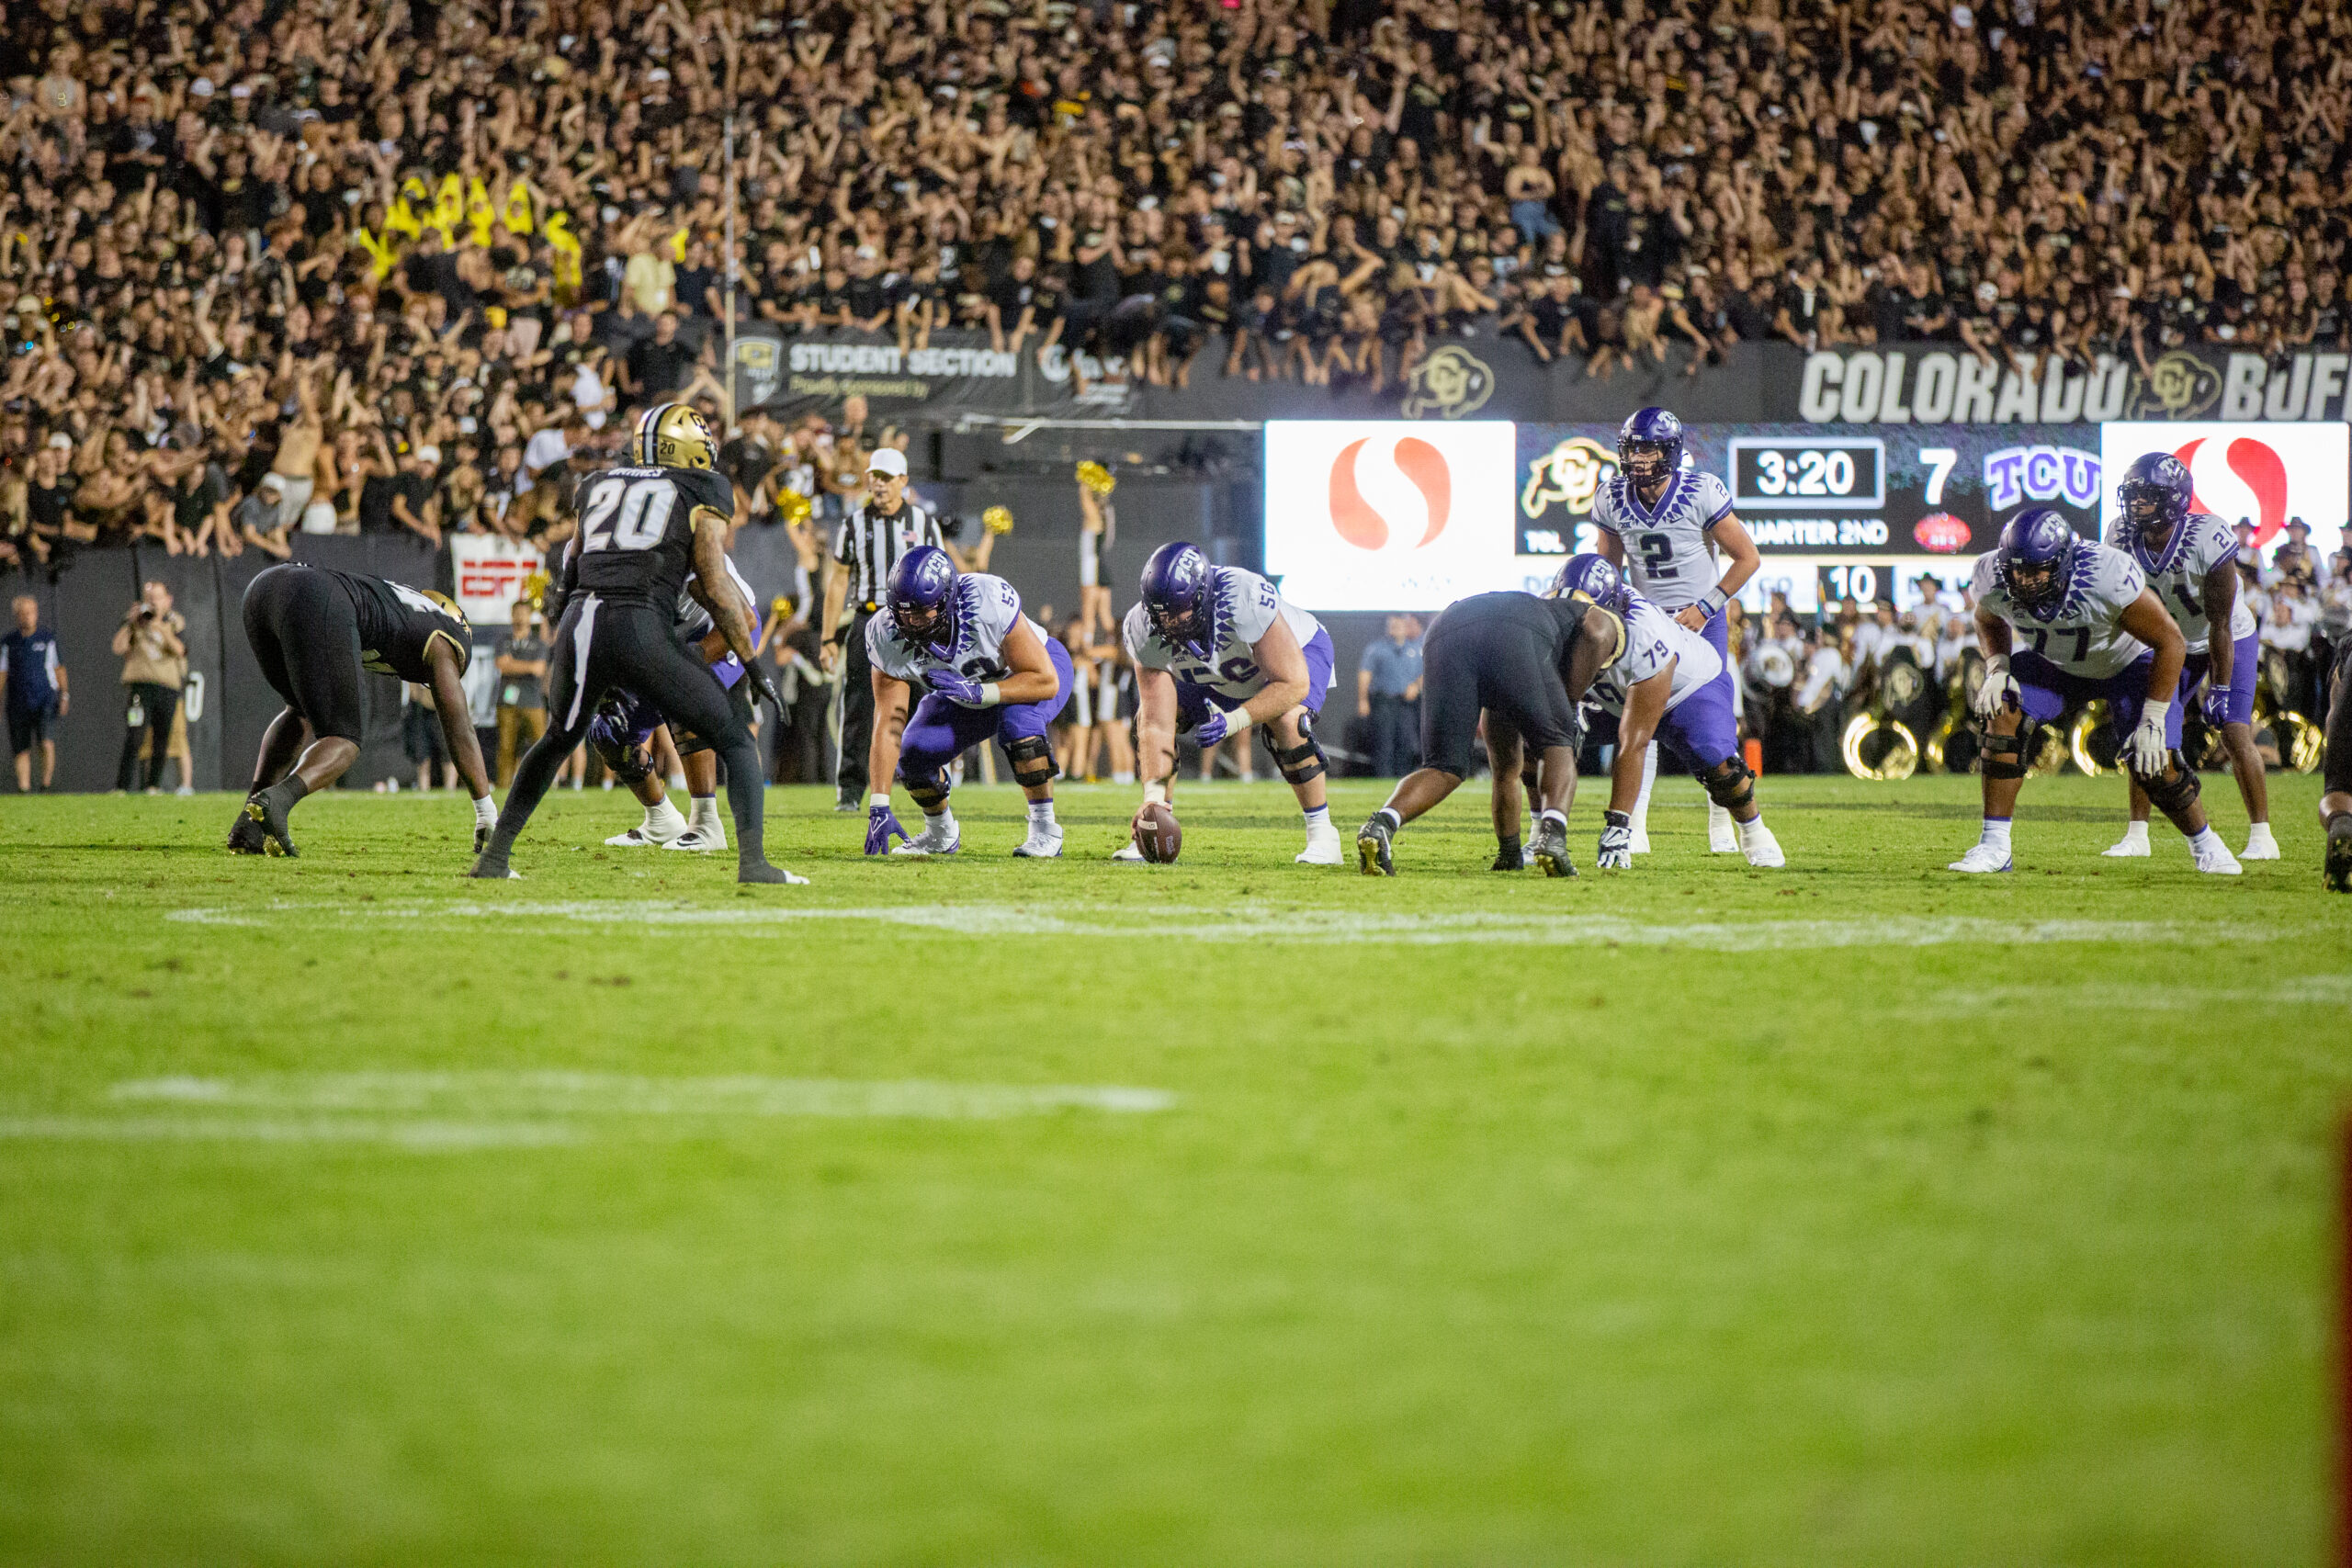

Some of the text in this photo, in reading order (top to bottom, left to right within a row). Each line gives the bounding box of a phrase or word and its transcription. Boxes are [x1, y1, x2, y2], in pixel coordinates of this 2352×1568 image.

[789, 344, 901, 374] STUDENT
[908, 347, 1018, 378] SECTION
[1799, 352, 2129, 423] COLORADO
[2220, 352, 2352, 421] BUF
[660, 442, 675, 456] 20
[1756, 449, 1855, 495] 3:20
[1918, 448, 1958, 505] 7
[1984, 445, 2101, 511] TCU
[583, 478, 678, 553] 20
[1741, 519, 1890, 546] UARTER 2ND
[2213, 525, 2233, 550] 21
[923, 552, 949, 585] TCU
[1174, 548, 1201, 584] TCU
[1639, 533, 1679, 579] 2
[1586, 558, 1613, 591] TCU
[1828, 566, 1876, 604] 10
[2123, 561, 2142, 592] 77
[1001, 581, 1015, 608] 53
[1642, 639, 1668, 669] 79
[2016, 626, 2091, 661] 77
